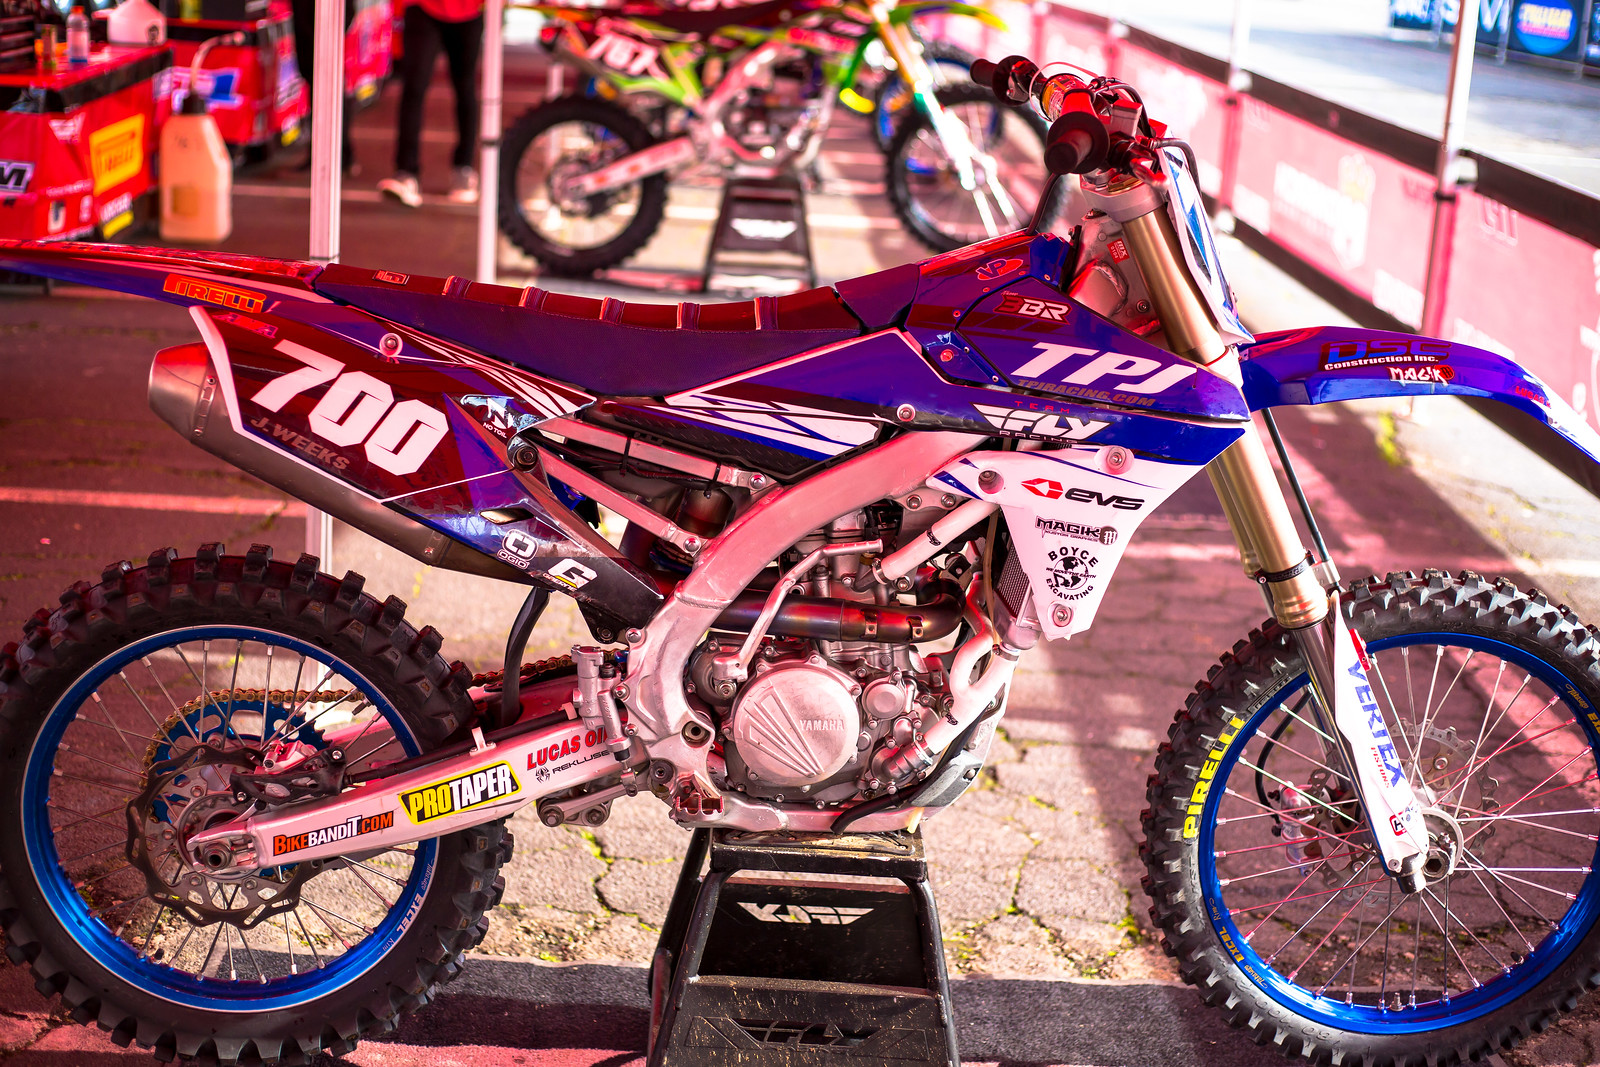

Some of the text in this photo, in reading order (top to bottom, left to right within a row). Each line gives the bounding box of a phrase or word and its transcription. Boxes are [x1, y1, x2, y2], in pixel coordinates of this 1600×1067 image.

[975, 258, 1008, 279] VP
[162, 273, 267, 314] PIRELLI
[1010, 341, 1198, 394] TPJ
[1324, 354, 1439, 371] Construction Inc.
[250, 338, 450, 476] 700
[1014, 400, 1070, 414] TEAM
[972, 402, 1112, 441] FLY
[999, 430, 1078, 444] RACING
[1035, 516, 1100, 538] MAGIK
[497, 550, 530, 569] OGIO
[1047, 546, 1099, 568] BOYCE
[1046, 578, 1094, 601] EXCAVATING
[800, 719, 845, 731] YAMAHA
[527, 735, 581, 771] LUCAS
[552, 749, 611, 775] REKLUSE
[1183, 716, 1246, 839] PIRELLI
[396, 892, 423, 933] EXCEL
[1219, 926, 1245, 963] EXCEL
